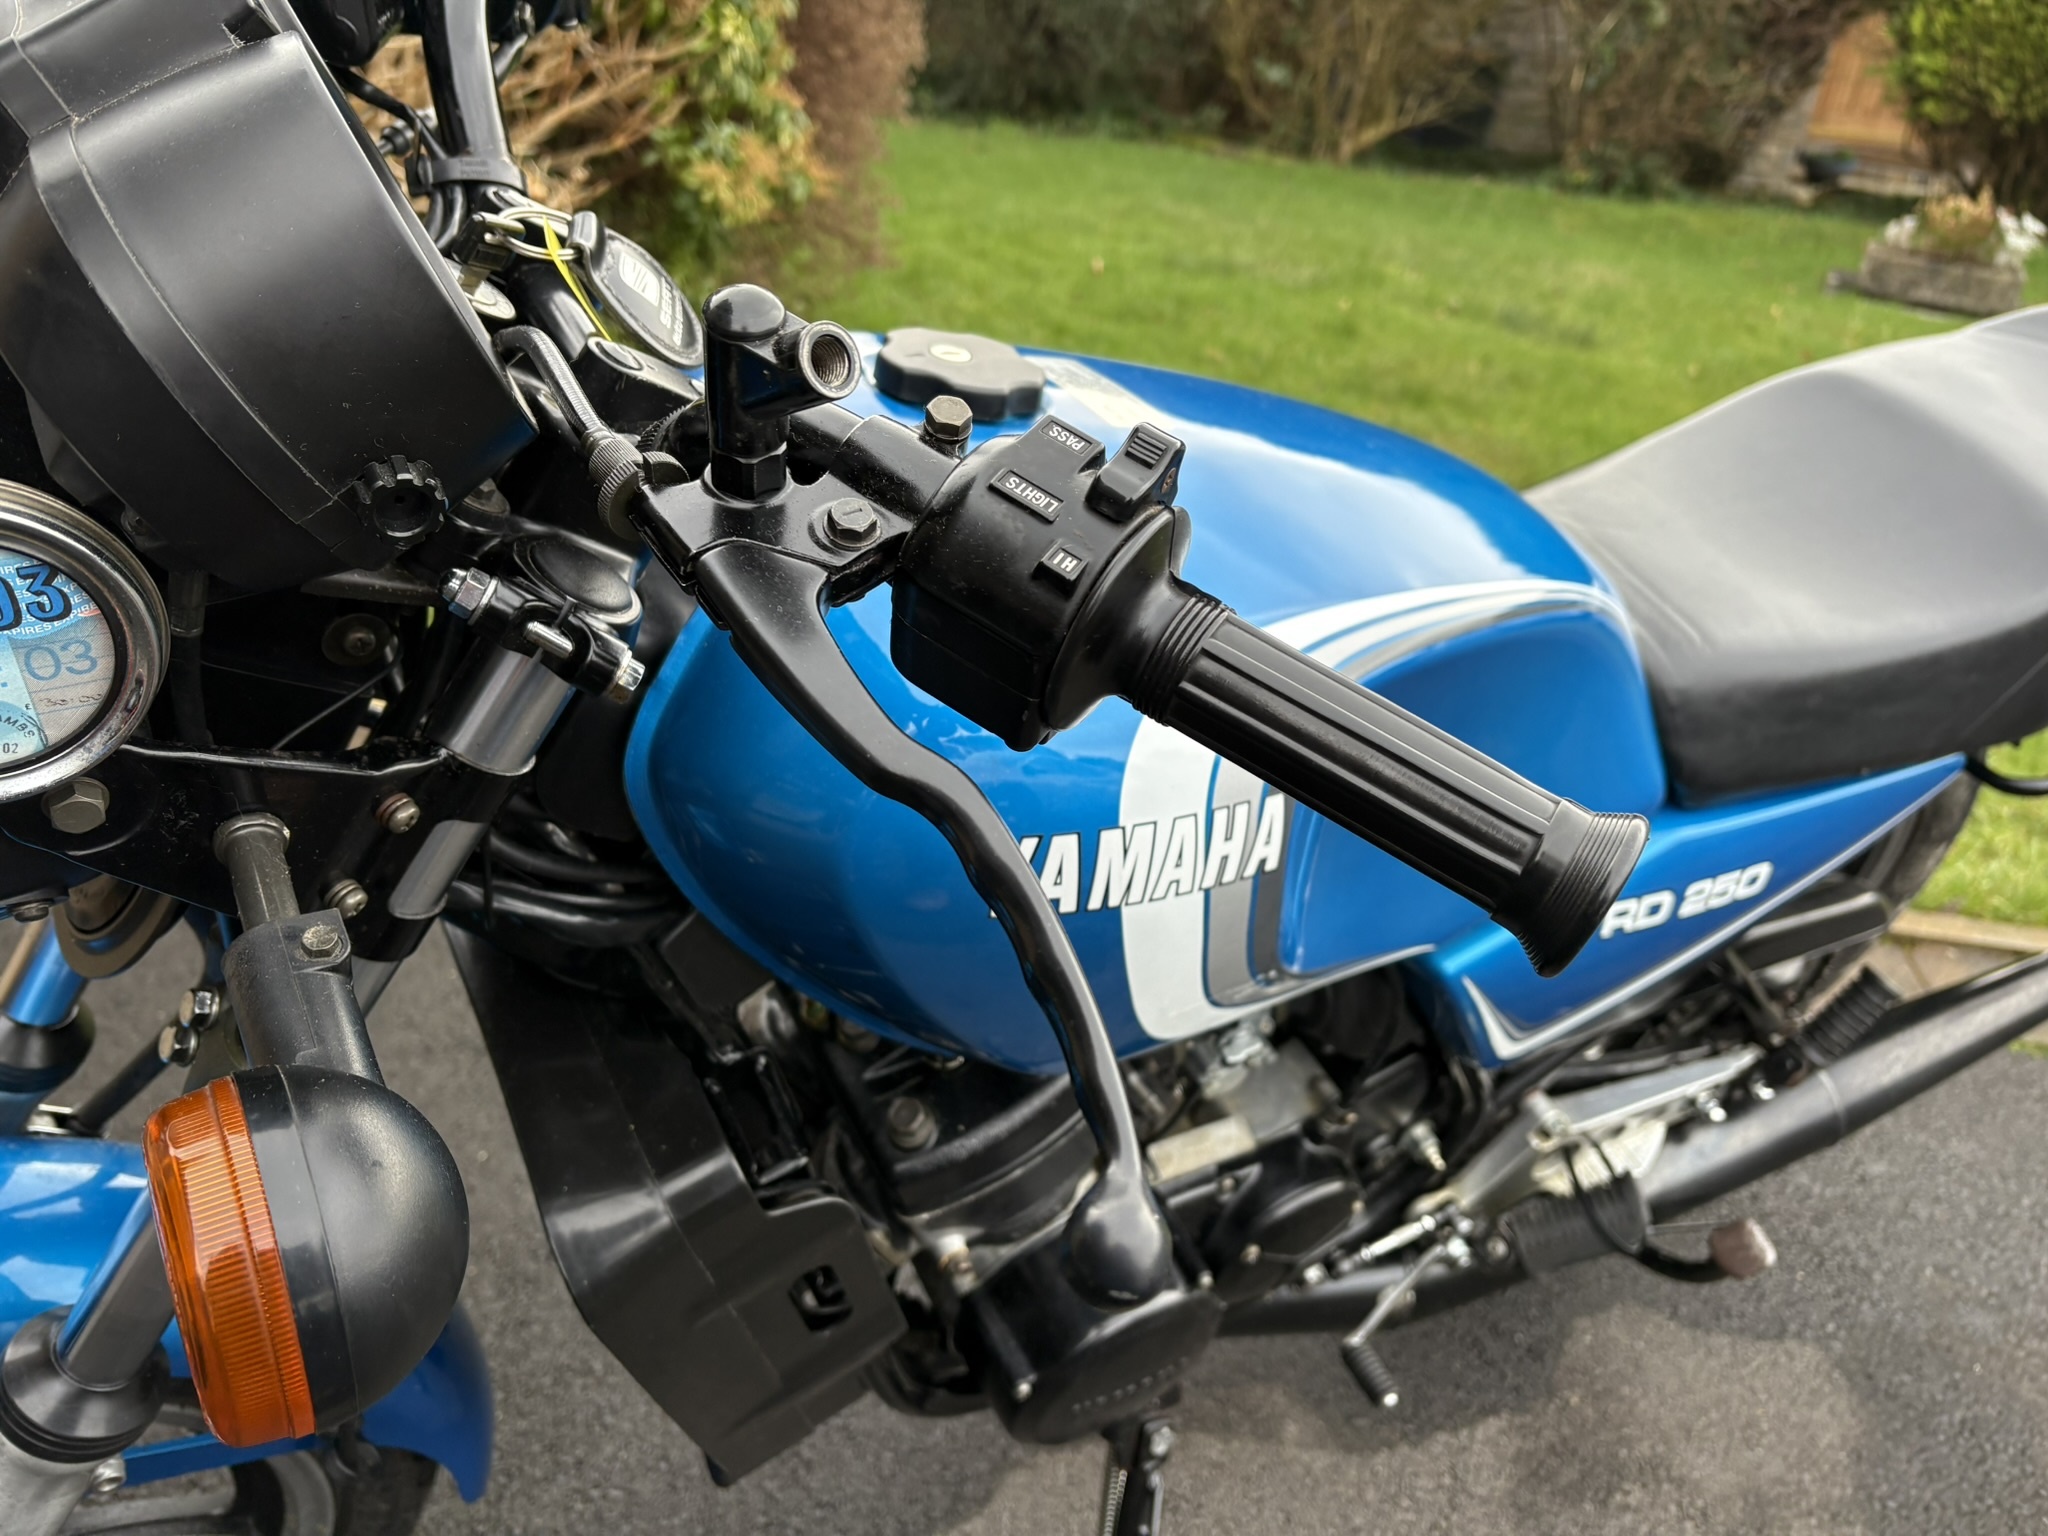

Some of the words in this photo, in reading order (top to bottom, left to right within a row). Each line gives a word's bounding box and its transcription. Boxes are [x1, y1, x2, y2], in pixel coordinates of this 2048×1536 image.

[1005, 476, 1059, 513] LIGHTS
[1052, 552, 1078, 573] HI
[24, 640, 98, 681] 03
[2, 742, 19, 754] 02
[1598, 889, 1677, 940] RD
[1677, 860, 1775, 920] 250
